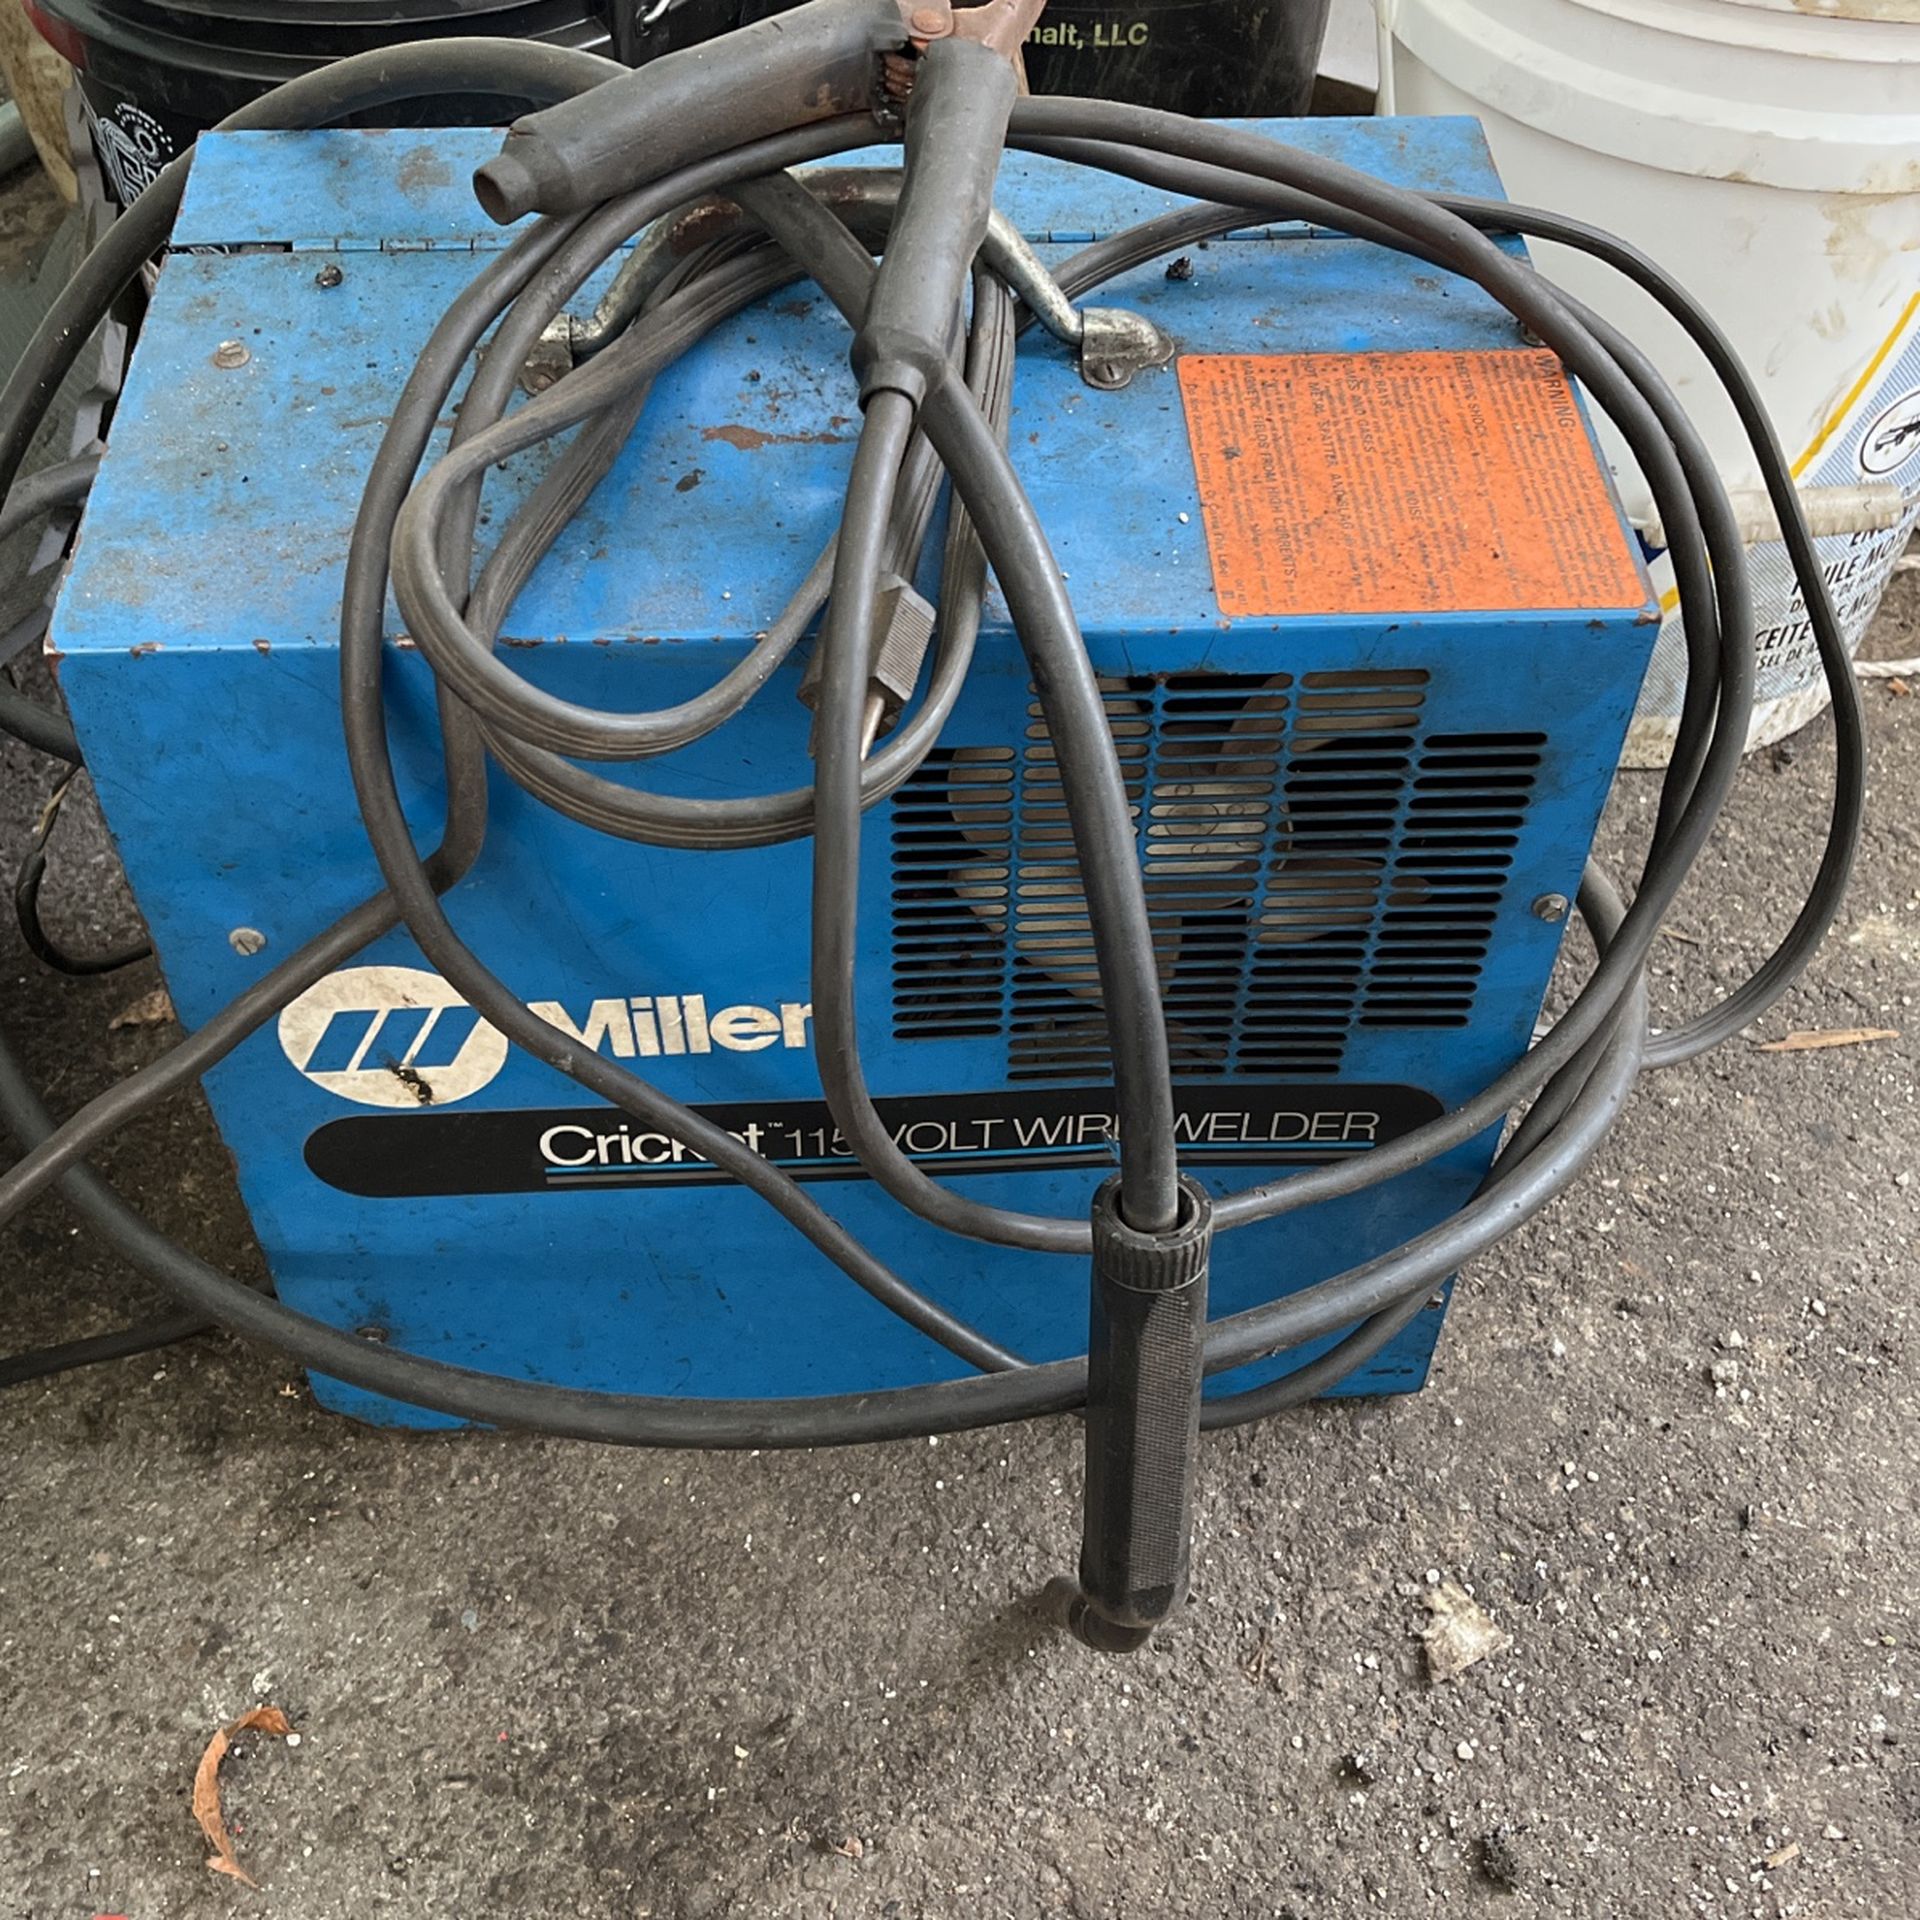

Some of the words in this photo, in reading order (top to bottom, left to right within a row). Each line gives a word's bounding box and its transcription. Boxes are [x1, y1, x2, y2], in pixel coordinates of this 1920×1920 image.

[1094, 22, 1148, 46] LLC
[1239, 360, 1262, 410] MAGNETIC
[1350, 395, 1366, 415] AND
[1467, 403, 1489, 437] SHOCK
[1251, 415, 1270, 448] FIELDS
[1356, 419, 1376, 452] GASES
[1259, 453, 1277, 482] FROM
[1374, 380, 1392, 406] RAYS
[1403, 490, 1423, 522] NOISE
[1266, 487, 1284, 512] HIGH
[1272, 517, 1297, 576] CURRENTS
[526, 994, 813, 1058] Miller
[784, 1128, 854, 1157] 115
[1172, 1110, 1381, 1142] WELDER
